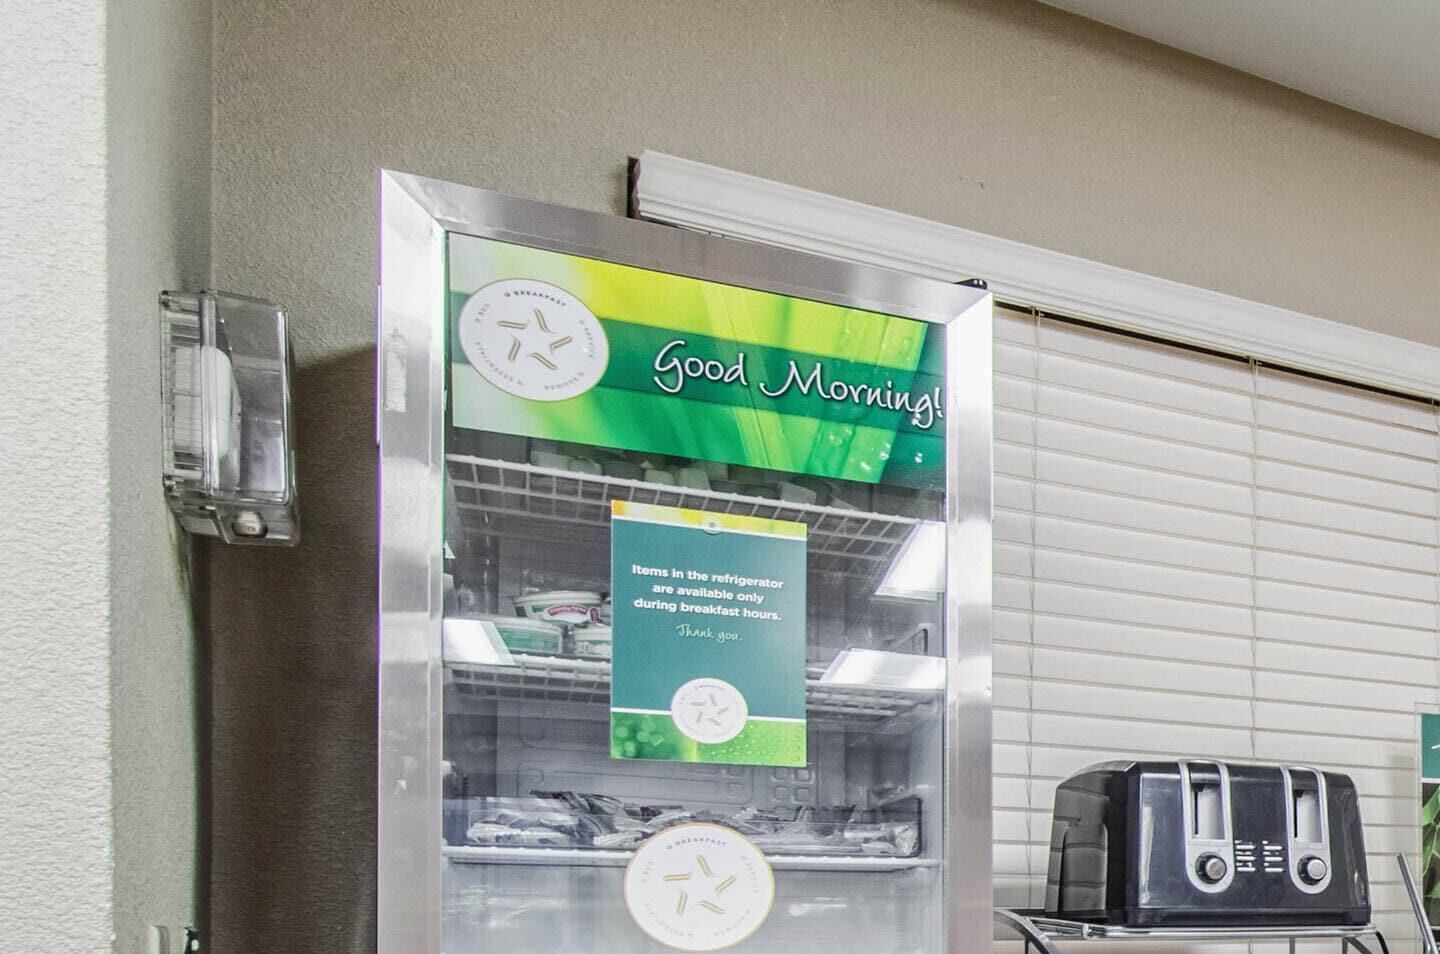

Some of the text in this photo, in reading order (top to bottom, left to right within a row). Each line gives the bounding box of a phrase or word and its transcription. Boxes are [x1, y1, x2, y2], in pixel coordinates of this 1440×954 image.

[653, 340, 944, 430] Good Morning!
[631, 564, 784, 589] Items in the refrigerator
[652, 584, 765, 605] are available only
[633, 597, 782, 621] during breakfast hours.
[676, 623, 743, 644] Thank you.
